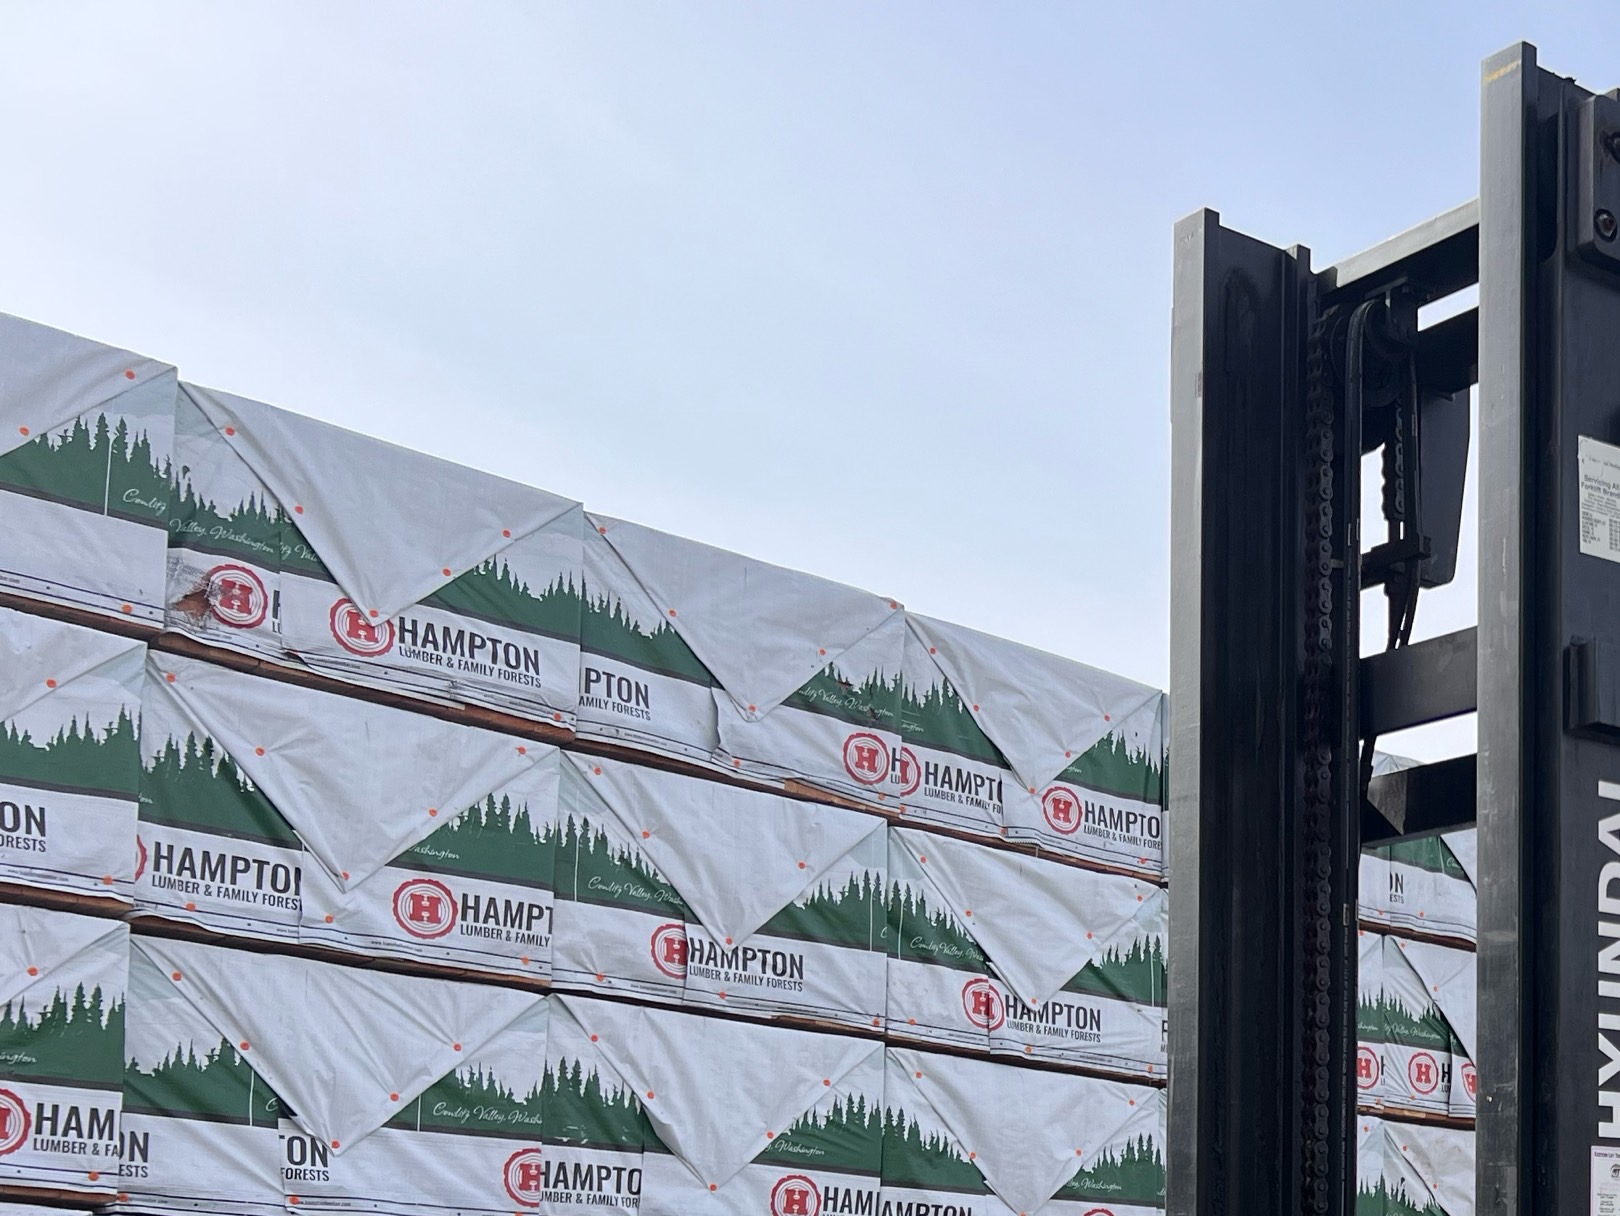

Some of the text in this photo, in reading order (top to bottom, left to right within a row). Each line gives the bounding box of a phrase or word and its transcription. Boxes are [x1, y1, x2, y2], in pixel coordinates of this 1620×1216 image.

[399, 616, 540, 676] HAMPTON
[399, 646, 542, 688] LUMBER & FAMILY FORESTS
[612, 700, 651, 720] FORESTS
[924, 787, 956, 802] LUMBER
[1084, 800, 1160, 839] HAMPTO
[1084, 824, 1110, 839] LUMBER
[1119, 834, 1142, 846] FAMILY
[152, 874, 200, 895] LUMBER
[204, 885, 212, 896] &
[217, 886, 258, 904] FAMILY
[460, 924, 551, 948] LUMBER & FAMILY
[689, 937, 804, 980] HAMPTON
[689, 965, 804, 992] LUMBER & FAMILY FORESTS
[1005, 994, 1102, 1032] HAMPTON
[1006, 1020, 1102, 1044] LUMBER & FAMILY FORESTS
[33, 1138, 86, 1155] LUMBER
[91, 1142, 100, 1156] &
[576, 1192, 582, 1204] &
[586, 1192, 619, 1207] FAMILY
